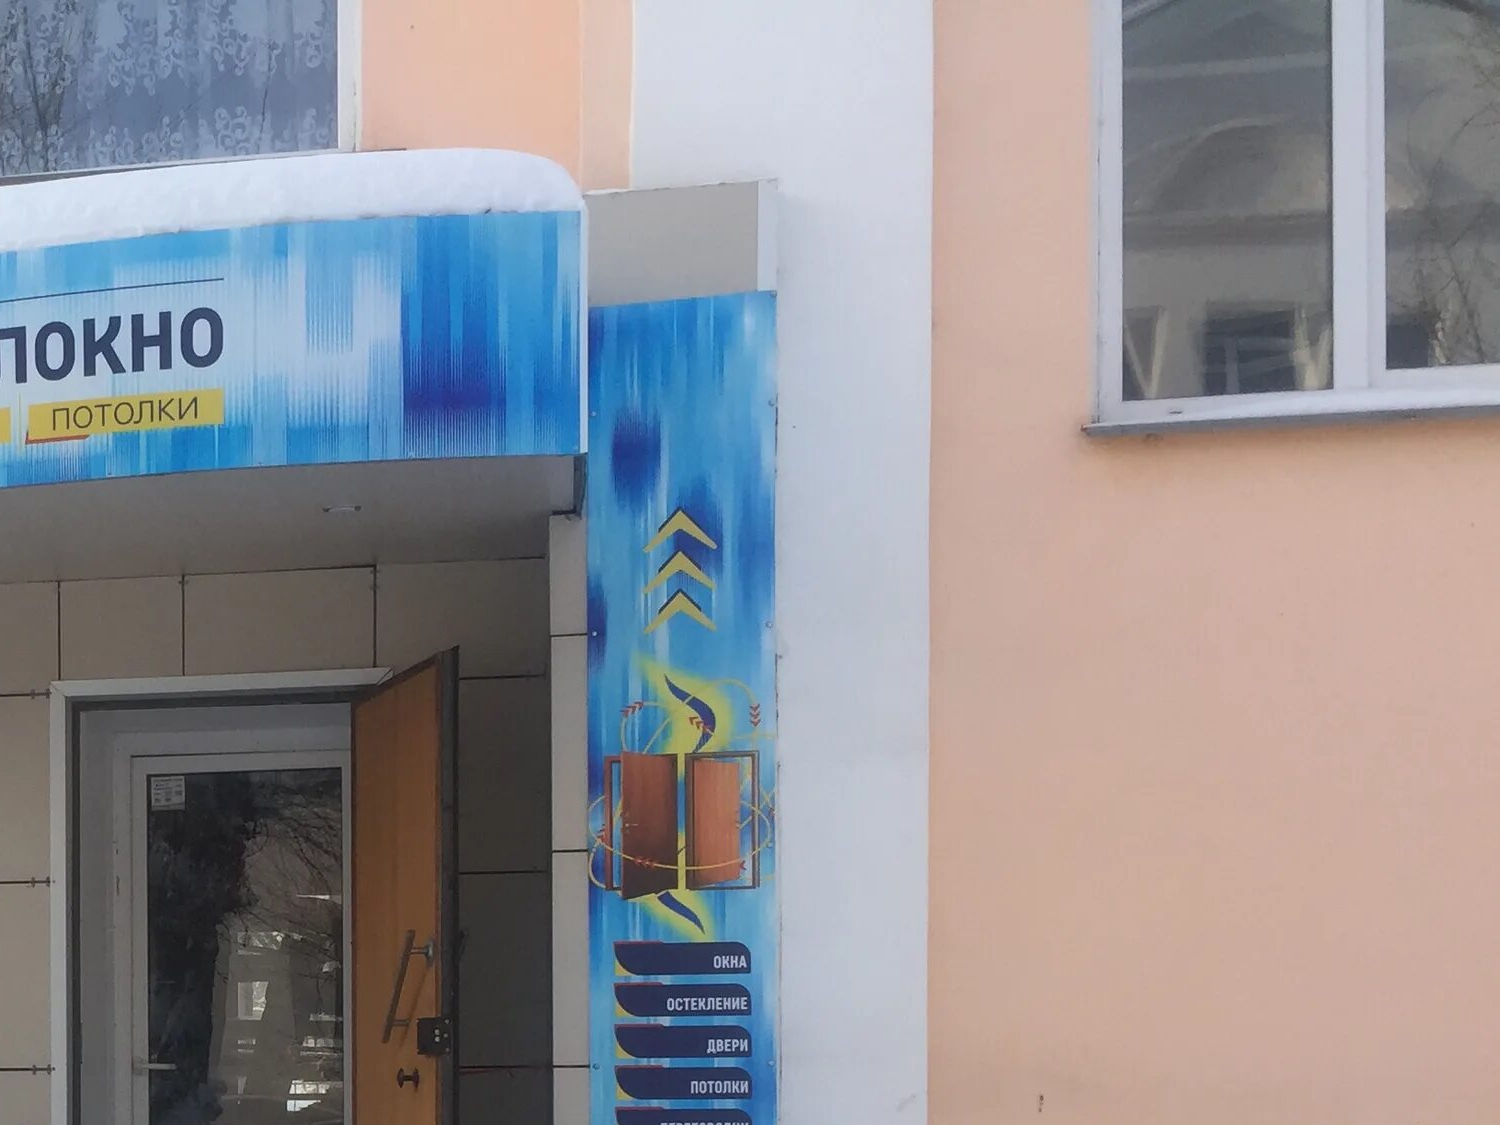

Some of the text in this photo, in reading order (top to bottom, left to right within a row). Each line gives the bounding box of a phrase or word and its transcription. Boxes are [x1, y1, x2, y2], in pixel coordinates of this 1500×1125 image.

[52, 396, 199, 431] потолки
[713, 955, 747, 969] ОКНА
[666, 997, 748, 1011] ОСТЕКЛЕНИЕ
[706, 1039, 749, 1054] ДВЕРИ
[690, 1080, 749, 1094] ПОТОЛКИ
